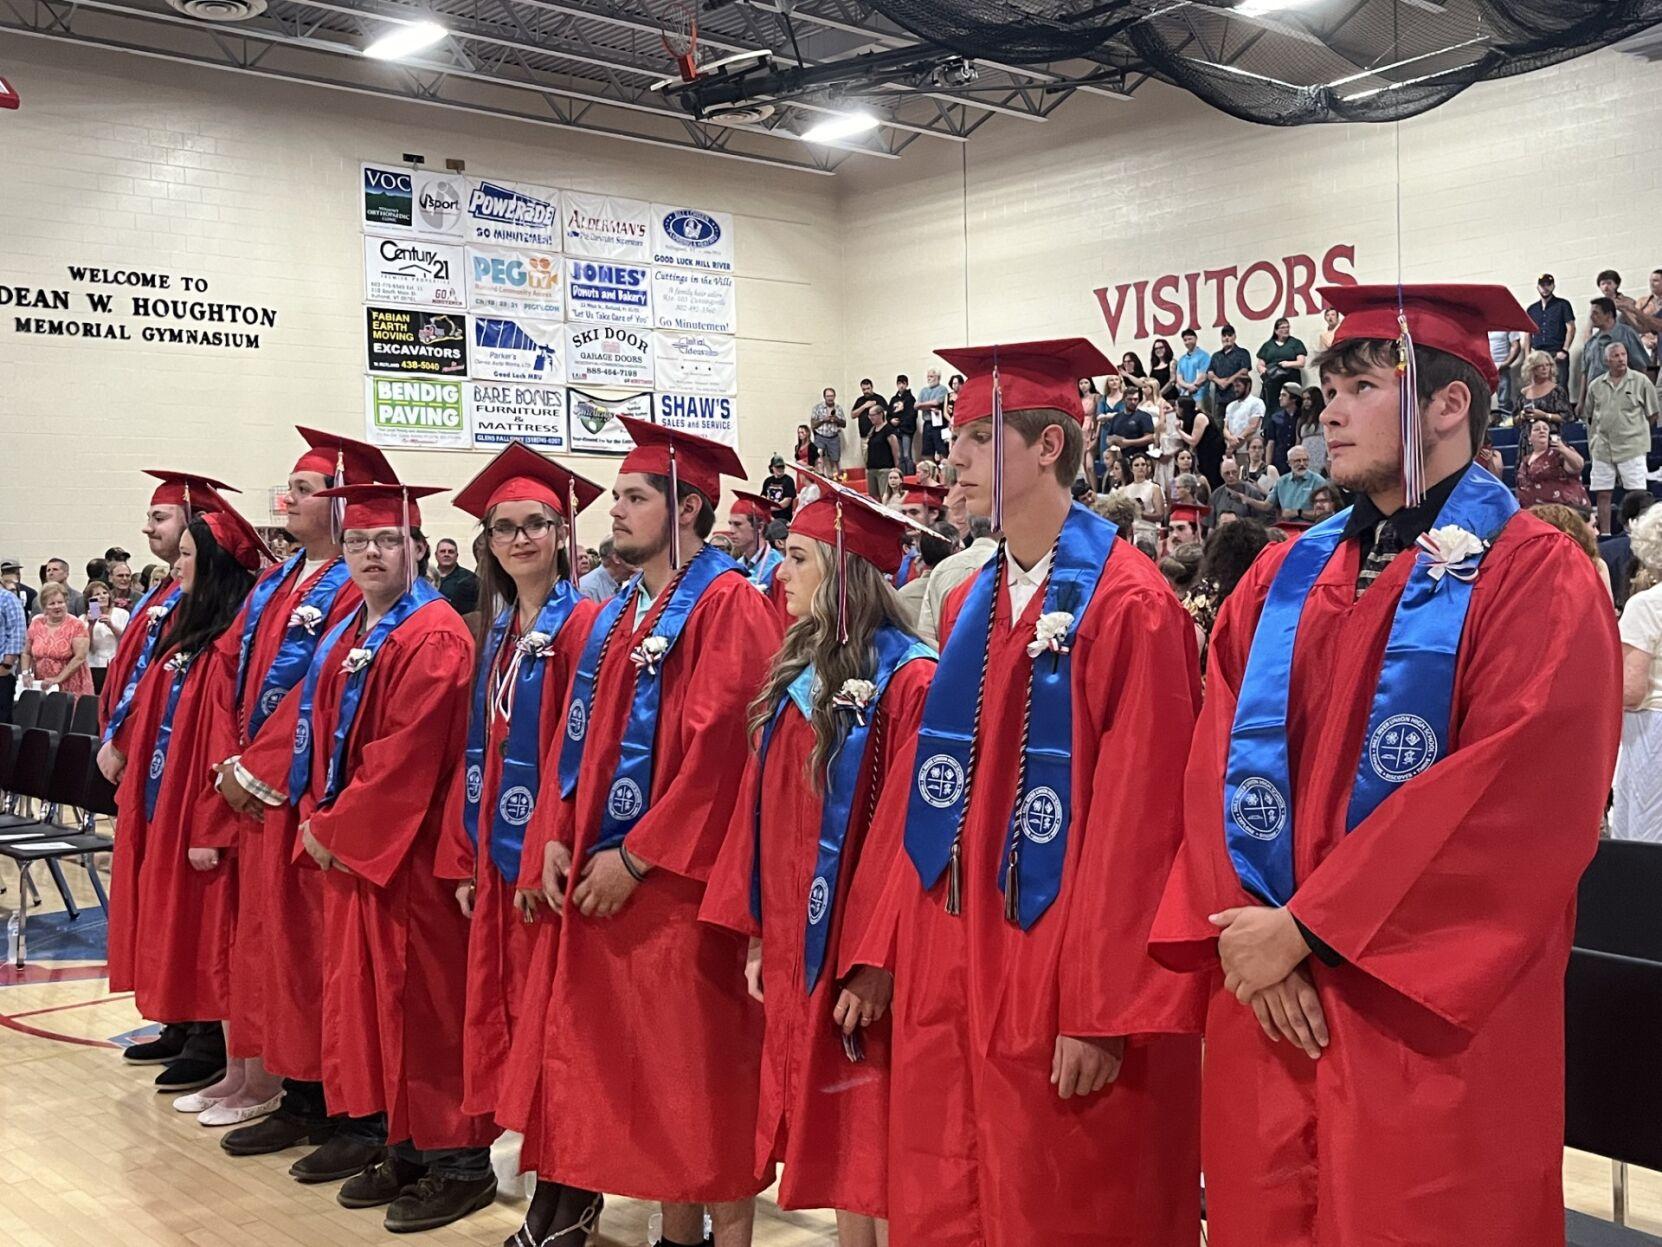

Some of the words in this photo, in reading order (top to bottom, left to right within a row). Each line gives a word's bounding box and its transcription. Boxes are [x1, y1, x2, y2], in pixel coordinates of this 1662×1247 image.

[366, 170, 411, 192] VOC
[568, 210, 646, 237] ALDERMAN'S
[380, 240, 437, 265] Century
[433, 260, 449, 280] 21
[654, 254, 674, 264] GOOD
[677, 257, 693, 266] LUCK
[695, 259, 710, 268] MILL
[712, 261, 731, 270] RIVER
[68, 266, 170, 289] WELCOME
[181, 277, 208, 292] TO
[473, 256, 527, 287] PEG
[571, 261, 646, 286] JONES'
[655, 271, 688, 284] Cuttings
[690, 275, 698, 283] in
[701, 275, 712, 285] the
[0, 285, 70, 310] DEAN
[86, 293, 113, 313] W.
[132, 297, 277, 327] HOUGHTON
[573, 285, 599, 298] Donuts
[601, 290, 616, 300] and
[618, 290, 646, 305] Bakery
[1093, 244, 1358, 346] VISITORS
[372, 311, 410, 323] FABIAN
[372, 322, 408, 332] EARTH
[659, 316, 672, 327] Go
[675, 318, 729, 332] Minutemen!
[14, 317, 131, 340] MEMORIAL
[142, 327, 260, 349] GYMNASIUM
[372, 330, 414, 342] MOVING
[572, 329, 599, 348] SKI
[605, 327, 648, 354] DOOR
[374, 343, 462, 359] EXCAVATORS
[580, 352, 613, 362] GARAGE
[615, 354, 643, 364] DOORS
[377, 381, 459, 403] BENDIG
[474, 385, 512, 404] BARE
[516, 388, 562, 407] BONES
[378, 405, 459, 427] PAVING
[476, 405, 560, 417] FURNITURE
[662, 395, 730, 419] SHAW'S
[479, 421, 559, 433] MATTRESS
[662, 418, 685, 428] SALES
[688, 420, 700, 428] and
[702, 421, 731, 430] SERVICE
[1389, 716, 1410, 725] UNION
[1410, 717, 1426, 730] HIGH
[1424, 728, 1435, 752] SCHOOL
